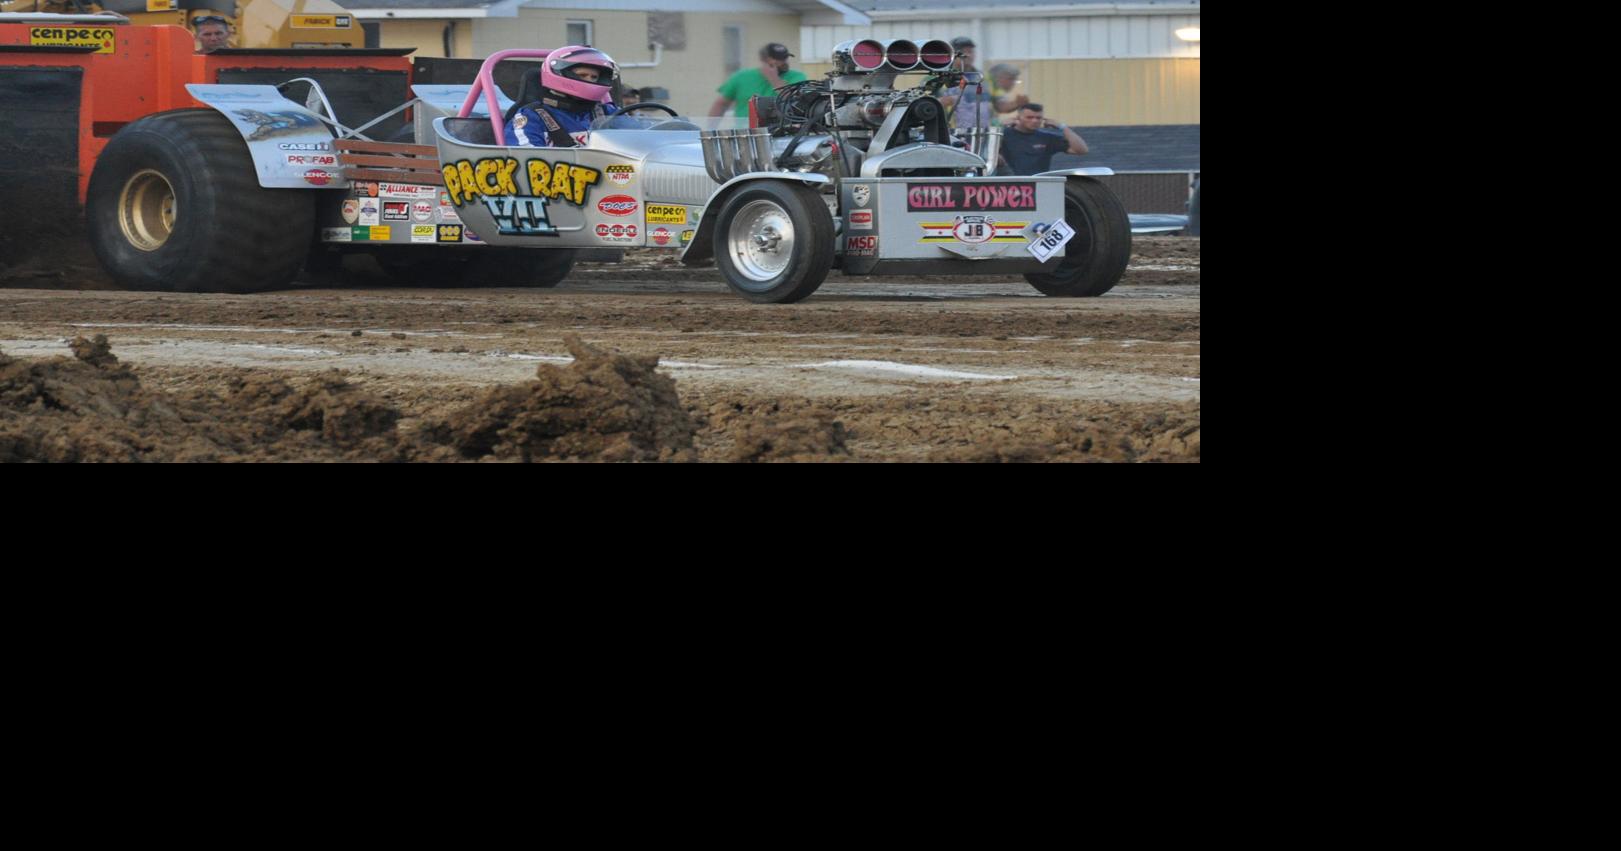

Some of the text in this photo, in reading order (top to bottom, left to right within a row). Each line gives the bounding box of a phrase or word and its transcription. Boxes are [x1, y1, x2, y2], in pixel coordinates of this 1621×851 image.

[386, 184, 418, 194] ALLIANCE
[442, 156, 602, 206] PACK RAT
[908, 185, 1035, 209] GIRL POWER
[482, 195, 560, 237] VII
[847, 236, 876, 249] MSD
[1040, 229, 1064, 251] 168
